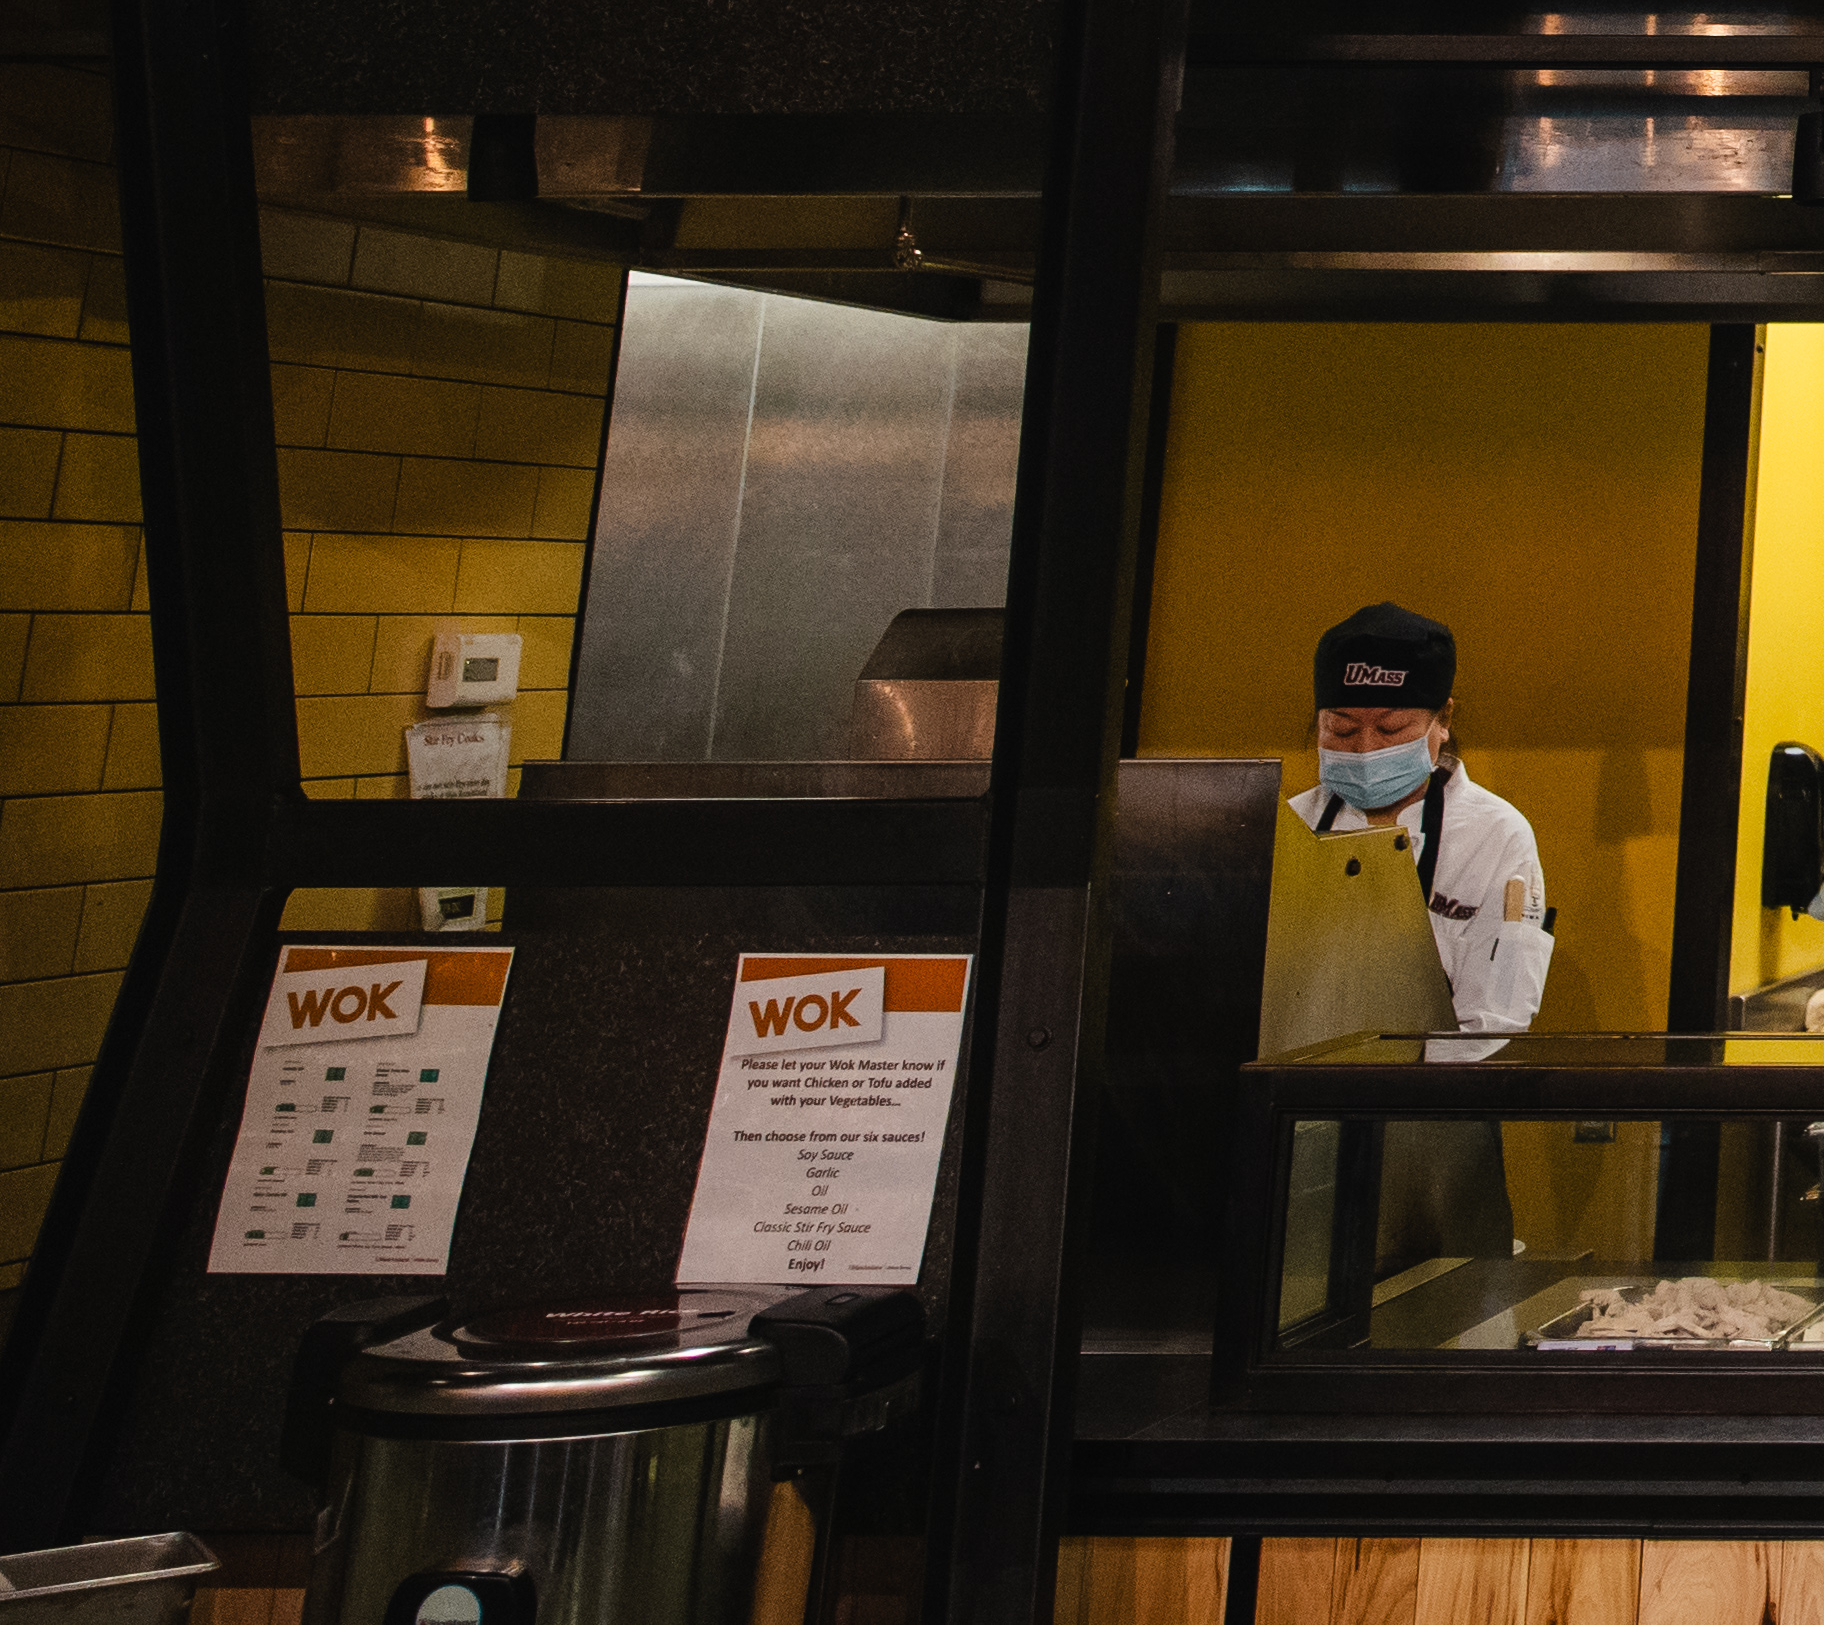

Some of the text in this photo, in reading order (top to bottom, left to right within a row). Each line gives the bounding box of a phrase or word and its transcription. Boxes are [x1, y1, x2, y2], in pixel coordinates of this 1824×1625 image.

[287, 980, 404, 1029] WOK
[748, 987, 863, 1038] WOK
[741, 1059, 946, 1074] Please let your Wok Master know if
[747, 1076, 932, 1091] you want Chicken or Tofu added
[770, 1095, 902, 1109] with your Vegetables...
[733, 1130, 926, 1142] Then choose from our six sauces!
[797, 1149, 854, 1162] Soy Sauce
[805, 1166, 840, 1178] Garlic
[811, 1185, 828, 1197] Oil
[784, 1203, 848, 1215] Sesame Oil
[753, 1221, 871, 1235] Classic Stir Fry Sauce
[787, 1239, 831, 1251] Chili Oil
[787, 1258, 825, 1272] Enjoy!
